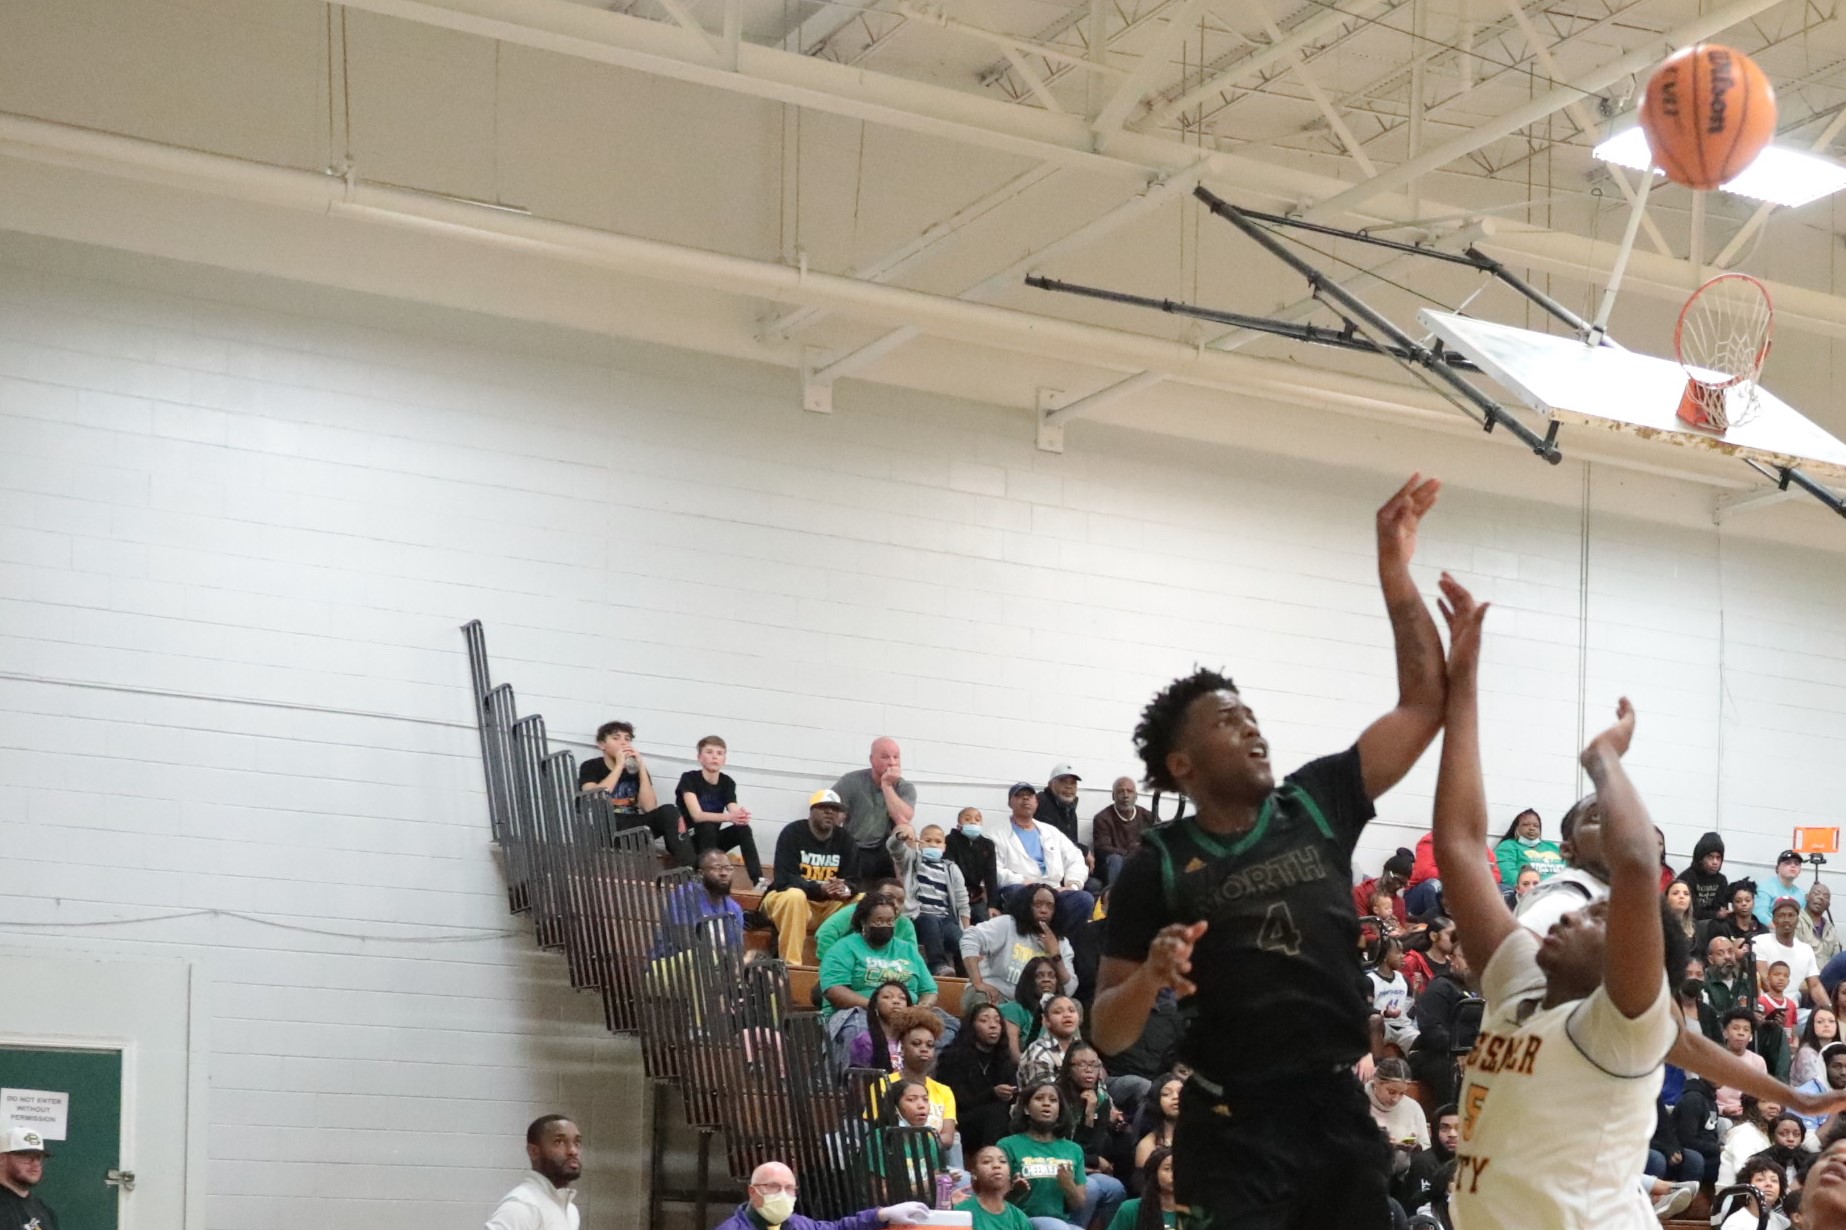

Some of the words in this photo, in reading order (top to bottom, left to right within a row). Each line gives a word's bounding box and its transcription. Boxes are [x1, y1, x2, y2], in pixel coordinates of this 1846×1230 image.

[1256, 901, 1301, 956] 4
[17, 1105, 51, 1113] WITHOUT
[10, 1114, 56, 1122] PERMISSION
